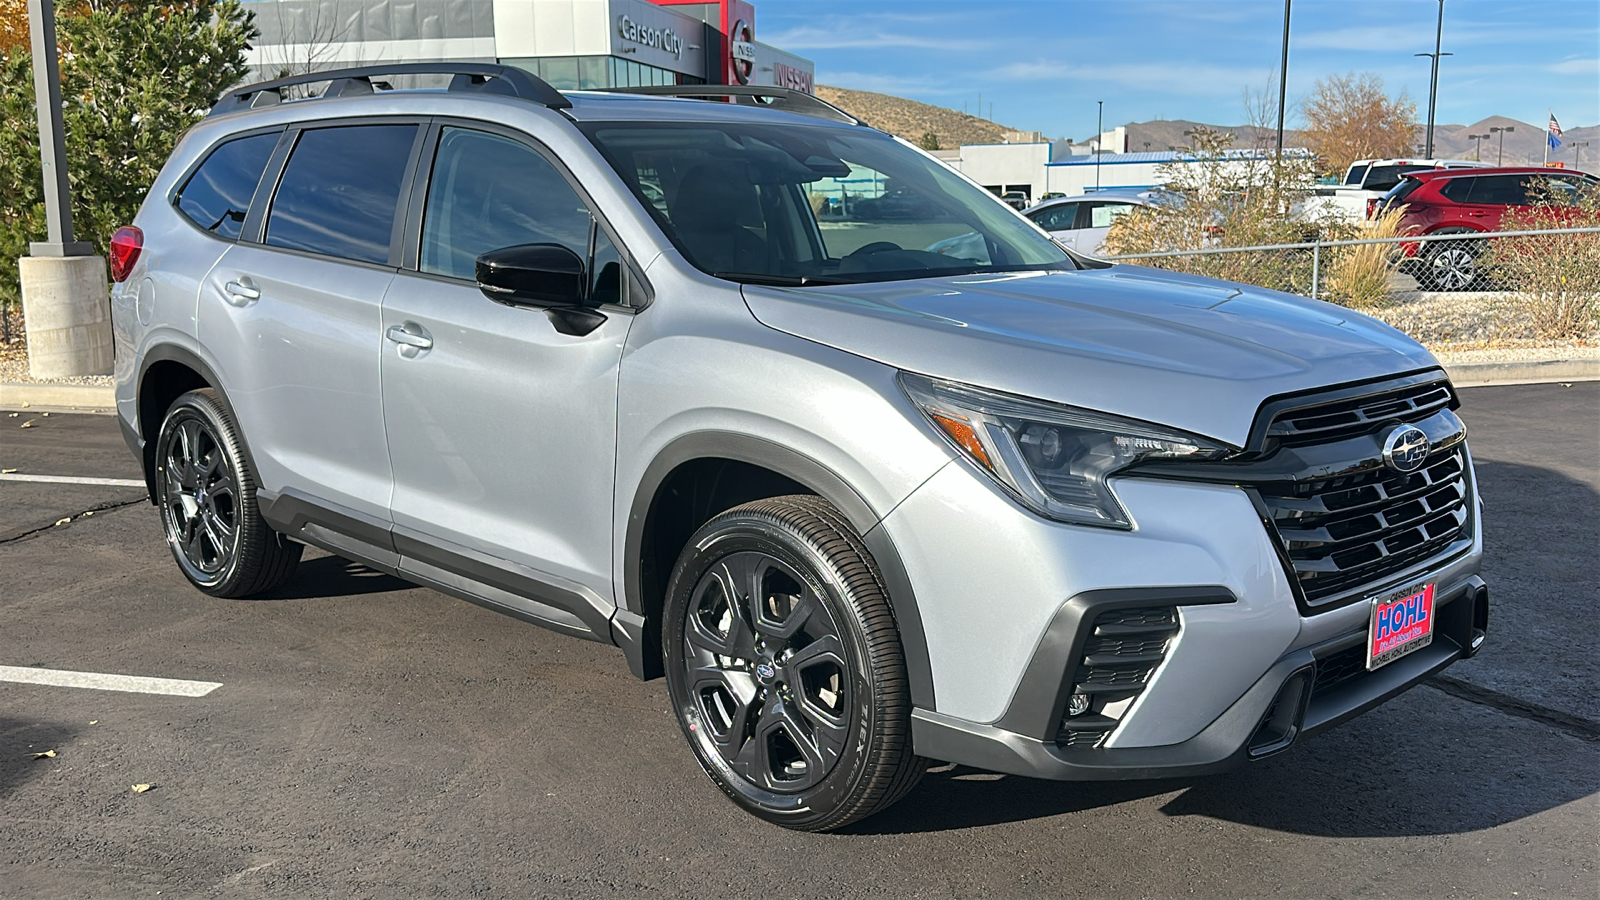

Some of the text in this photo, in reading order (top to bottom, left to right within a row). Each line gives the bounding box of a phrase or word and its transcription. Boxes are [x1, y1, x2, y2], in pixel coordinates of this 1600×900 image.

[620, 14, 684, 61] Carson City
[738, 44, 755, 57] NISS
[775, 62, 813, 94] NISSAN
[1376, 593, 1427, 640] HOHL
